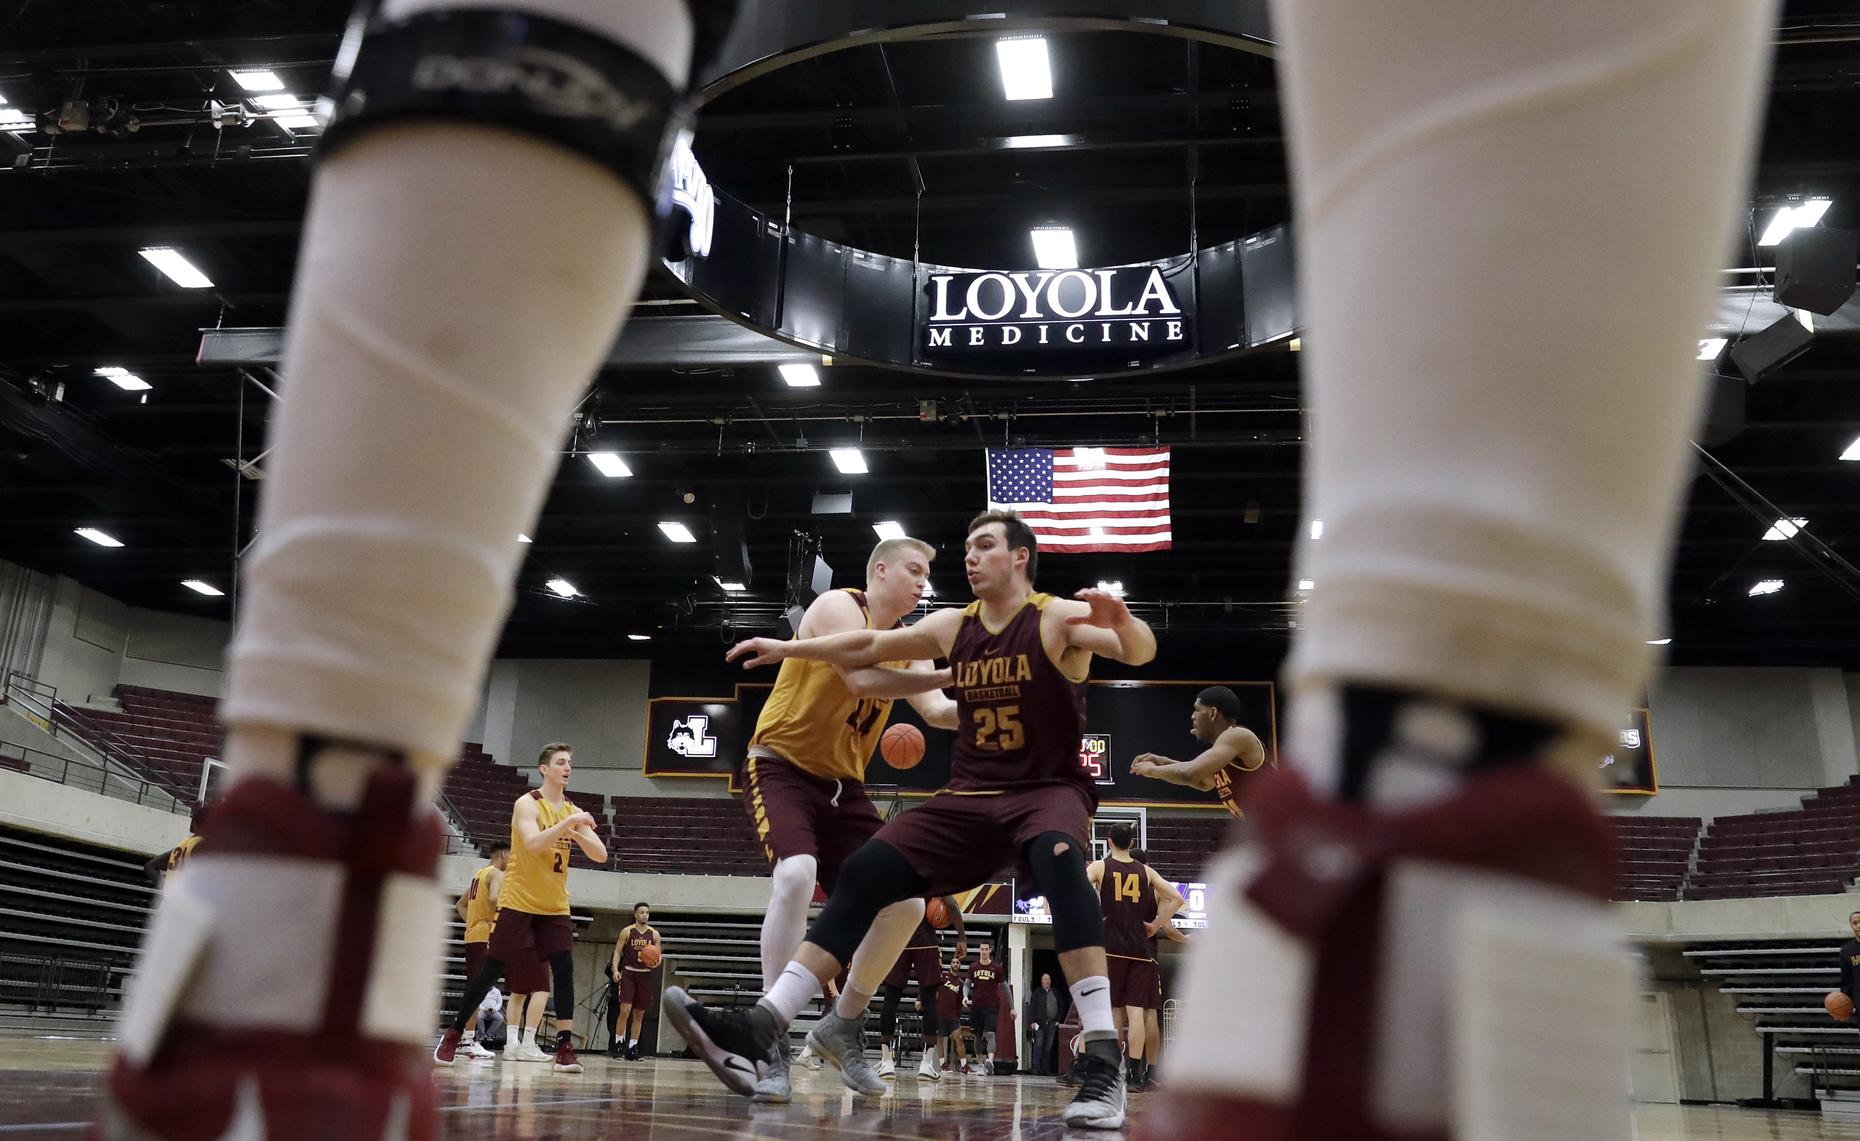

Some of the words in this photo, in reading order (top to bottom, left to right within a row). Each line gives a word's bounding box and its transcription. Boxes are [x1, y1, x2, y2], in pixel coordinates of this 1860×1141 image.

[929, 268, 1181, 321] LOYOLA
[928, 321, 1183, 346] MEDICINE
[956, 654, 1032, 688] LOYOLA
[973, 705, 1025, 750] 25
[553, 852, 564, 873] 2
[1112, 871, 1141, 903] 14
